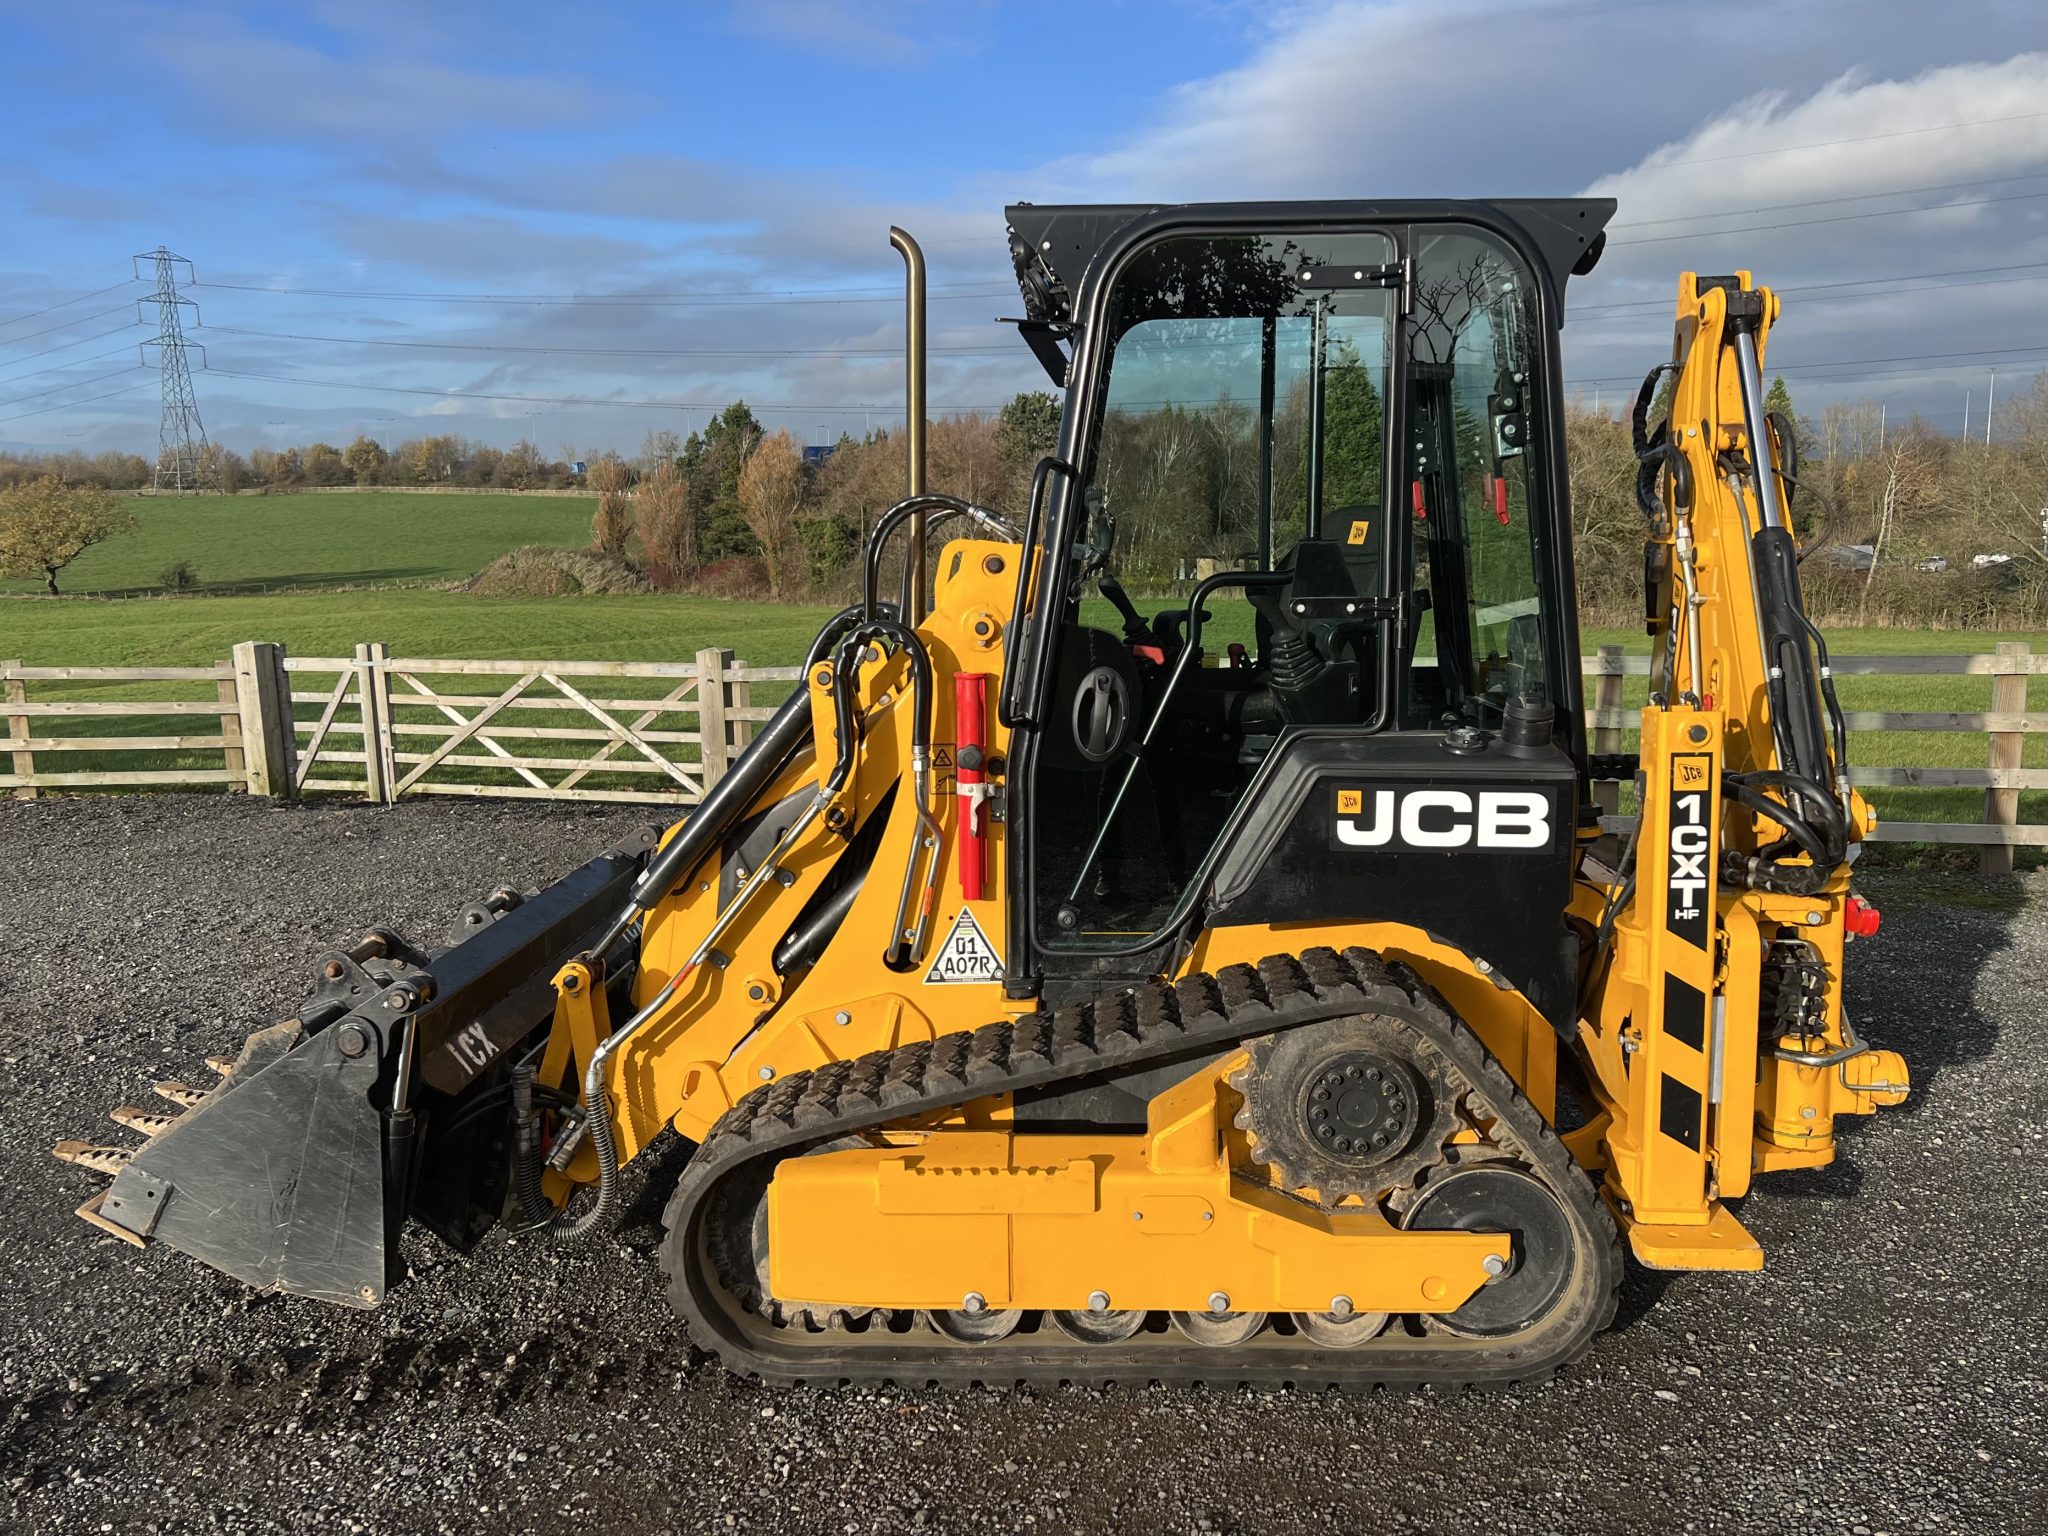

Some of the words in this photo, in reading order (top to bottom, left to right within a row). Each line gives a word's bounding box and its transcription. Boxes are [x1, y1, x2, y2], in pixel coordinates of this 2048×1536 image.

[1683, 765, 1703, 782] JCB
[1337, 790, 1550, 848] JCB
[1670, 794, 1708, 908] 1CXT
[1674, 909, 1700, 920] HF
